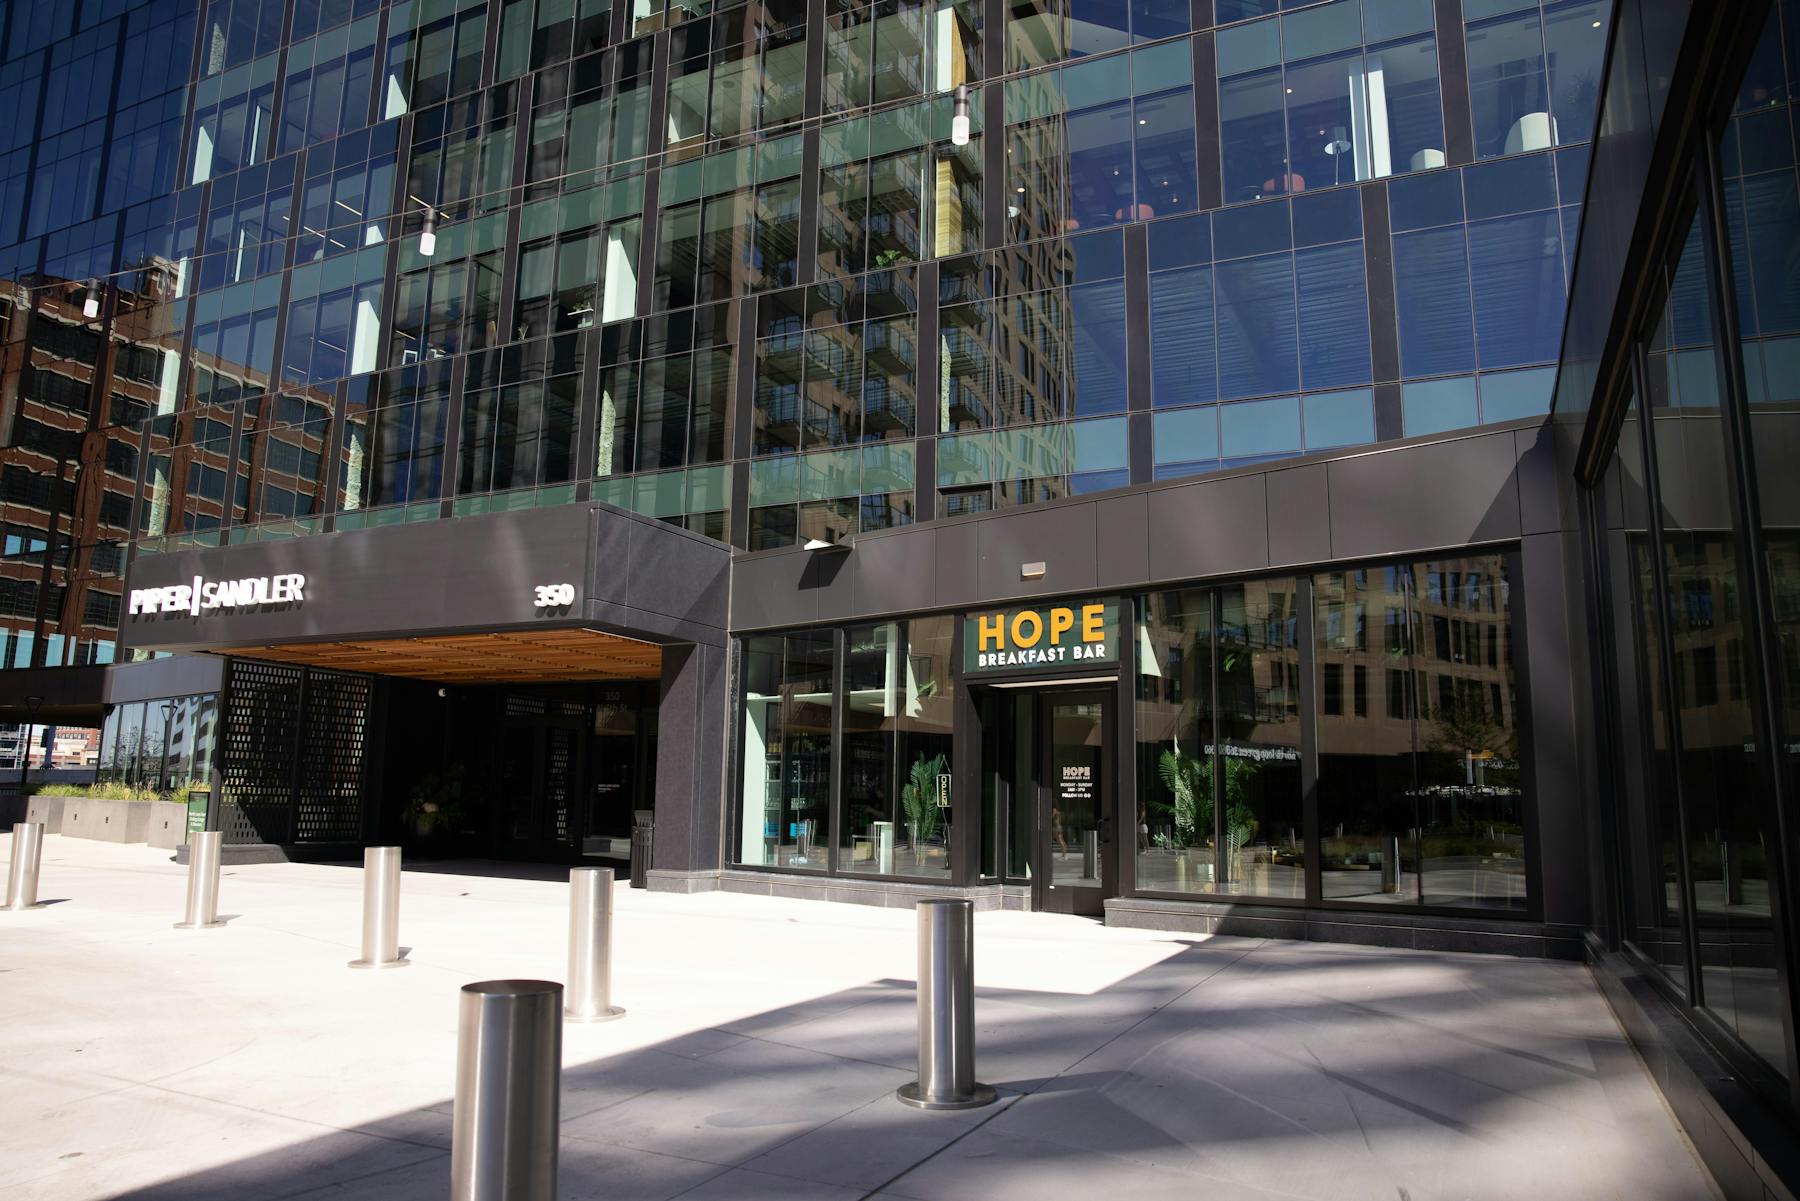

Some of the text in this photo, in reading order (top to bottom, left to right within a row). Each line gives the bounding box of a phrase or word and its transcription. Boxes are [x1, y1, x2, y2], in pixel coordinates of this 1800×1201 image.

[534, 583, 574, 607] 350
[979, 604, 1105, 651] HOPE
[979, 644, 1105, 667] BREAKFAST BAR
[1062, 766, 1091, 776] HOPE
[940, 776, 948, 806] OPEN
